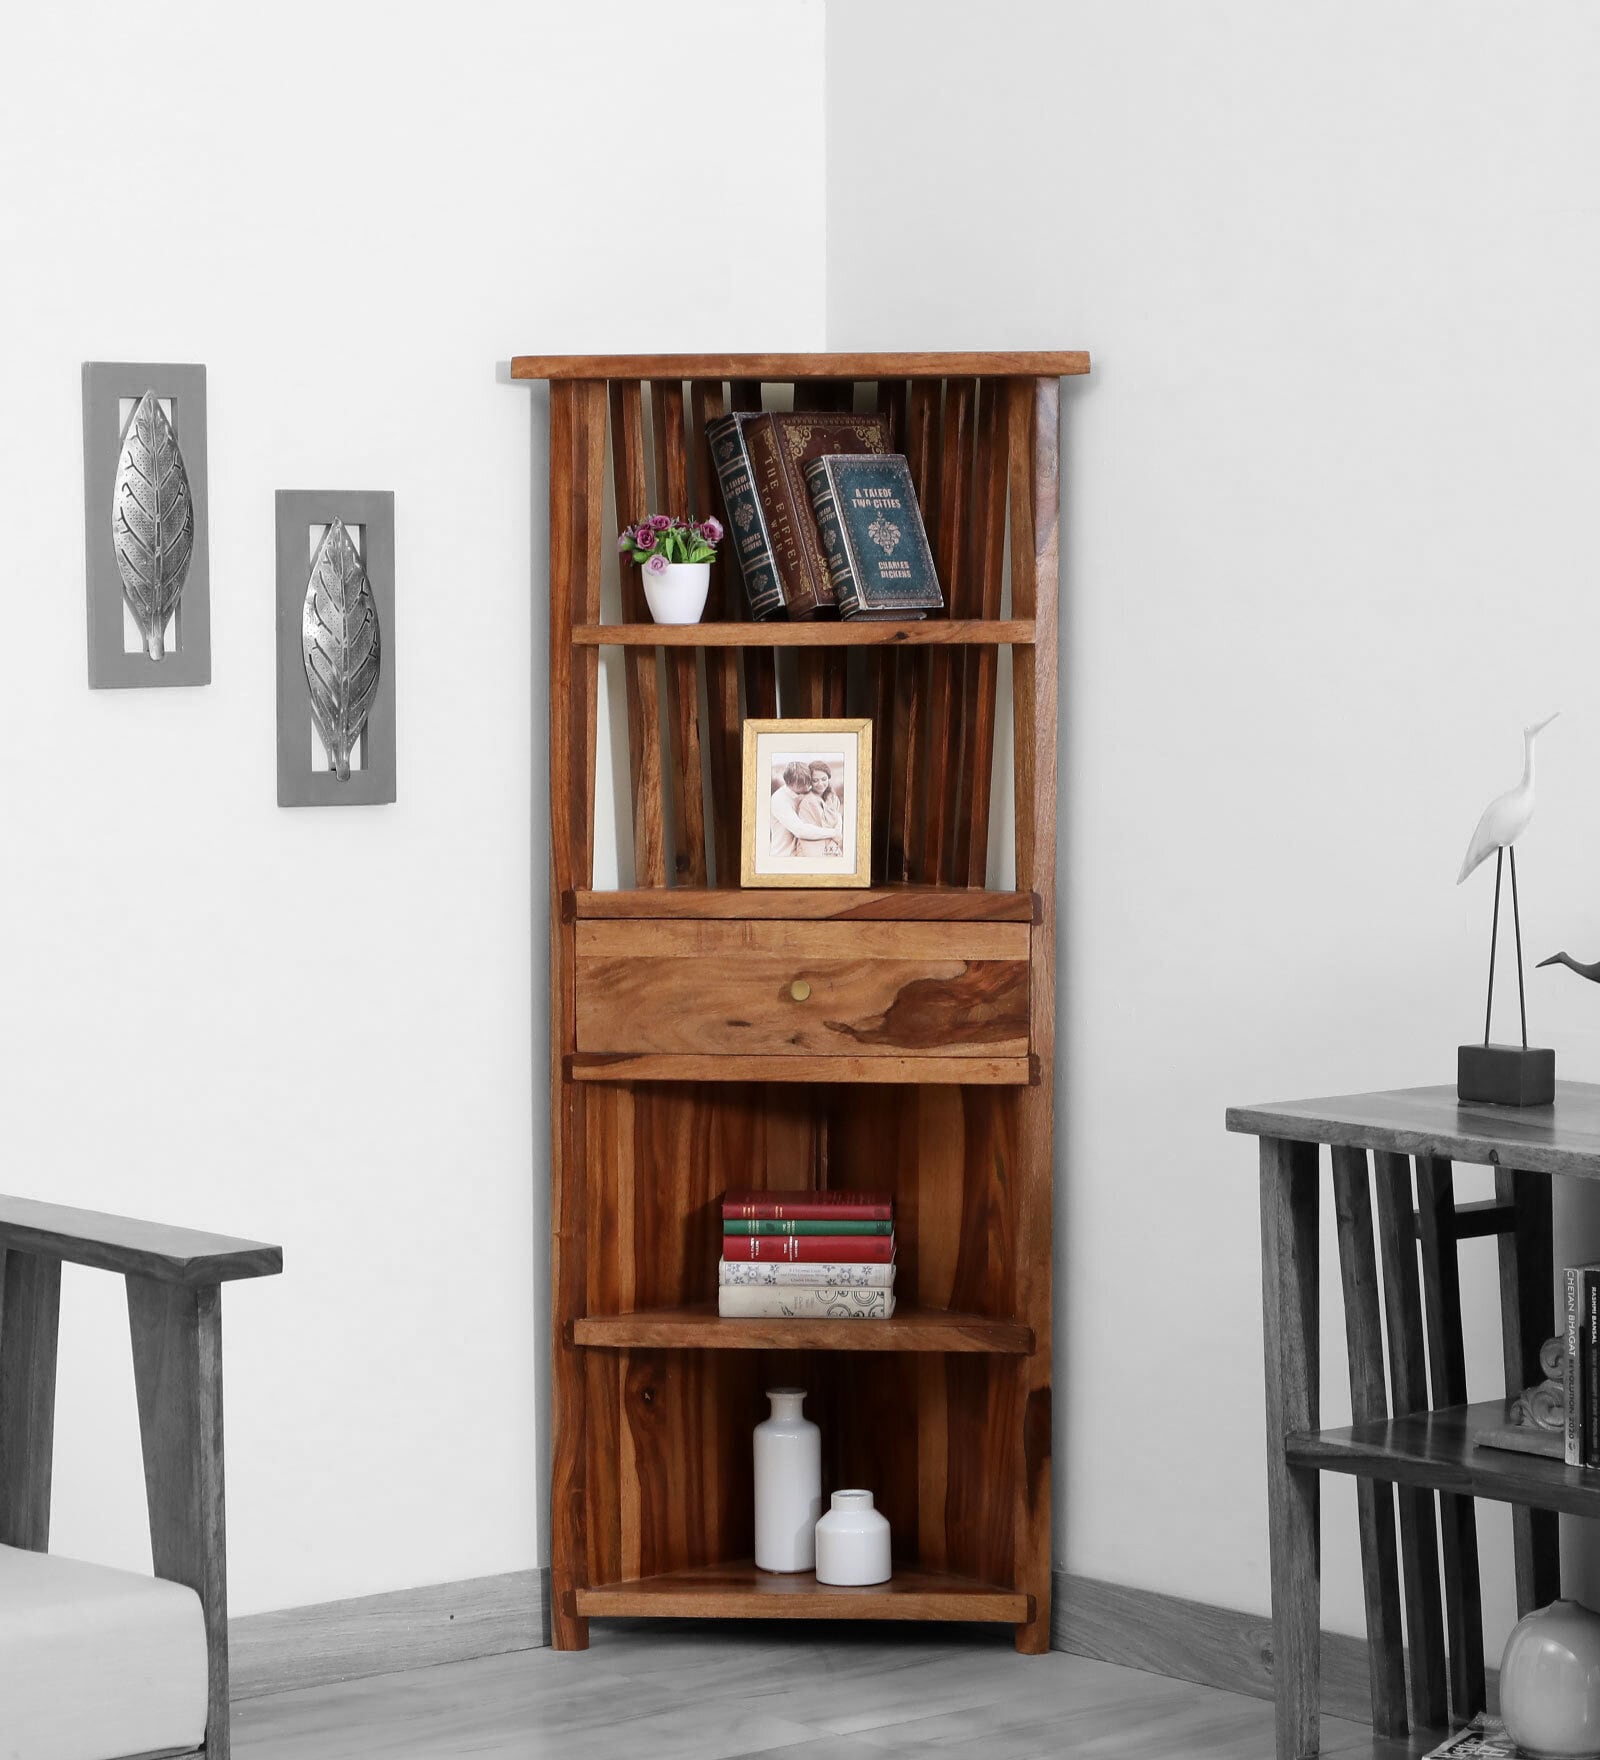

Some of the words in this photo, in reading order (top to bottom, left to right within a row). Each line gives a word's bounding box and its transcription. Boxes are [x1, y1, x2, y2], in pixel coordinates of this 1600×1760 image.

[855, 488, 862, 498] A
[873, 499, 901, 508] CITIES
[764, 456, 779, 490] THE
[776, 503, 799, 571] EIFFEL
[880, 570, 911, 578] DICKENS
[1567, 1270, 1575, 1312] CHETAN
[1568, 1314, 1576, 1357] BHAGAT
